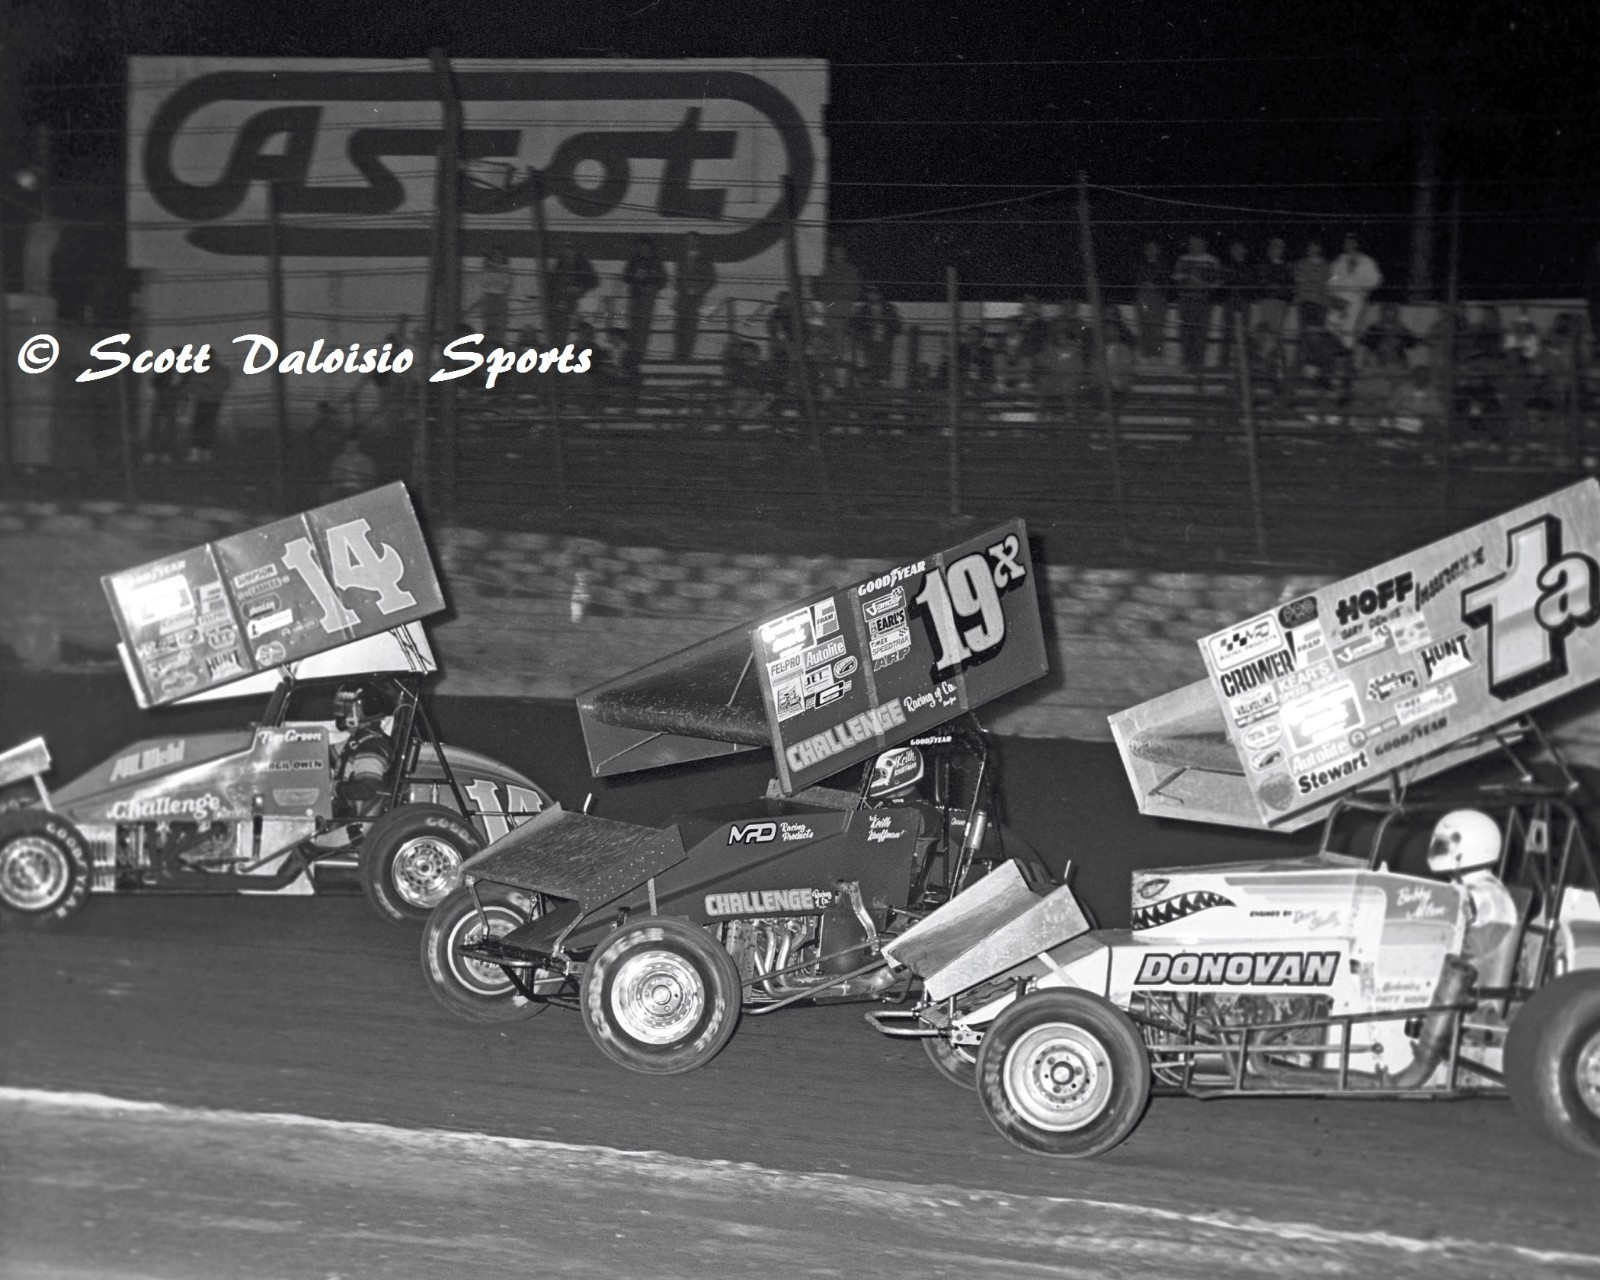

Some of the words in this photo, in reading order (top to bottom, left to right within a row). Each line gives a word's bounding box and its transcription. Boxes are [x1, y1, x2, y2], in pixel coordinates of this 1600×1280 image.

[281, 518, 417, 634] 14
[858, 560, 926, 596] GOODYEAR
[1335, 570, 1414, 627] HOFF
[816, 613, 834, 626] FRAM
[876, 609, 905, 632] EARL'S
[206, 650, 243, 681] HUNT
[806, 639, 845, 669] Autolite
[873, 646, 911, 672] ARP
[1421, 633, 1473, 681] HUNT
[1220, 648, 1296, 699] CROWER
[1278, 661, 1331, 693] KEAR'S
[284, 729, 322, 743] Green
[786, 698, 907, 772] CHALLENGE
[904, 693, 936, 713] Racing
[910, 735, 952, 746] GOODYEAR
[293, 760, 323, 770] OWEN
[1292, 739, 1350, 773] Autolite
[1298, 751, 1369, 795] Stewart
[107, 792, 220, 819] Challenge
[780, 822, 807, 834] Racing
[782, 828, 814, 842] Products
[705, 887, 815, 917] CHALLENGE
[1134, 951, 1341, 987] DONOVAN
